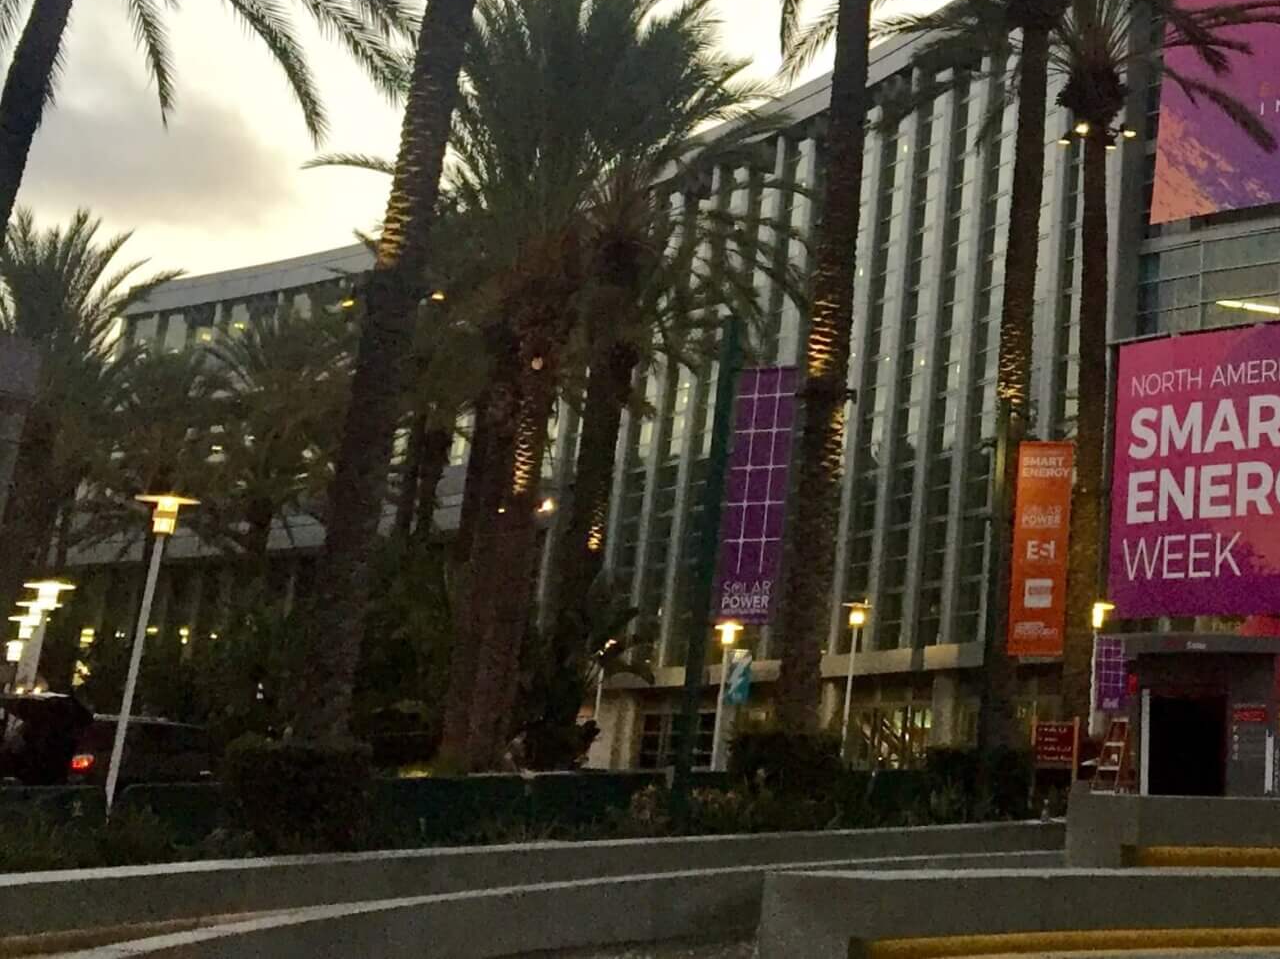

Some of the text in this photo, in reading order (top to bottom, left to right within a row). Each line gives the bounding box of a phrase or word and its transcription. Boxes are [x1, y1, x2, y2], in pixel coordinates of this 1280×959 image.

[1131, 368, 1201, 397] NORTH
[1023, 456, 1064, 466] SMART
[1023, 467, 1069, 477] ENERGY
[1122, 532, 1242, 581] WEEK
[723, 581, 771, 596] SOLAR
[722, 595, 769, 609] POWER
